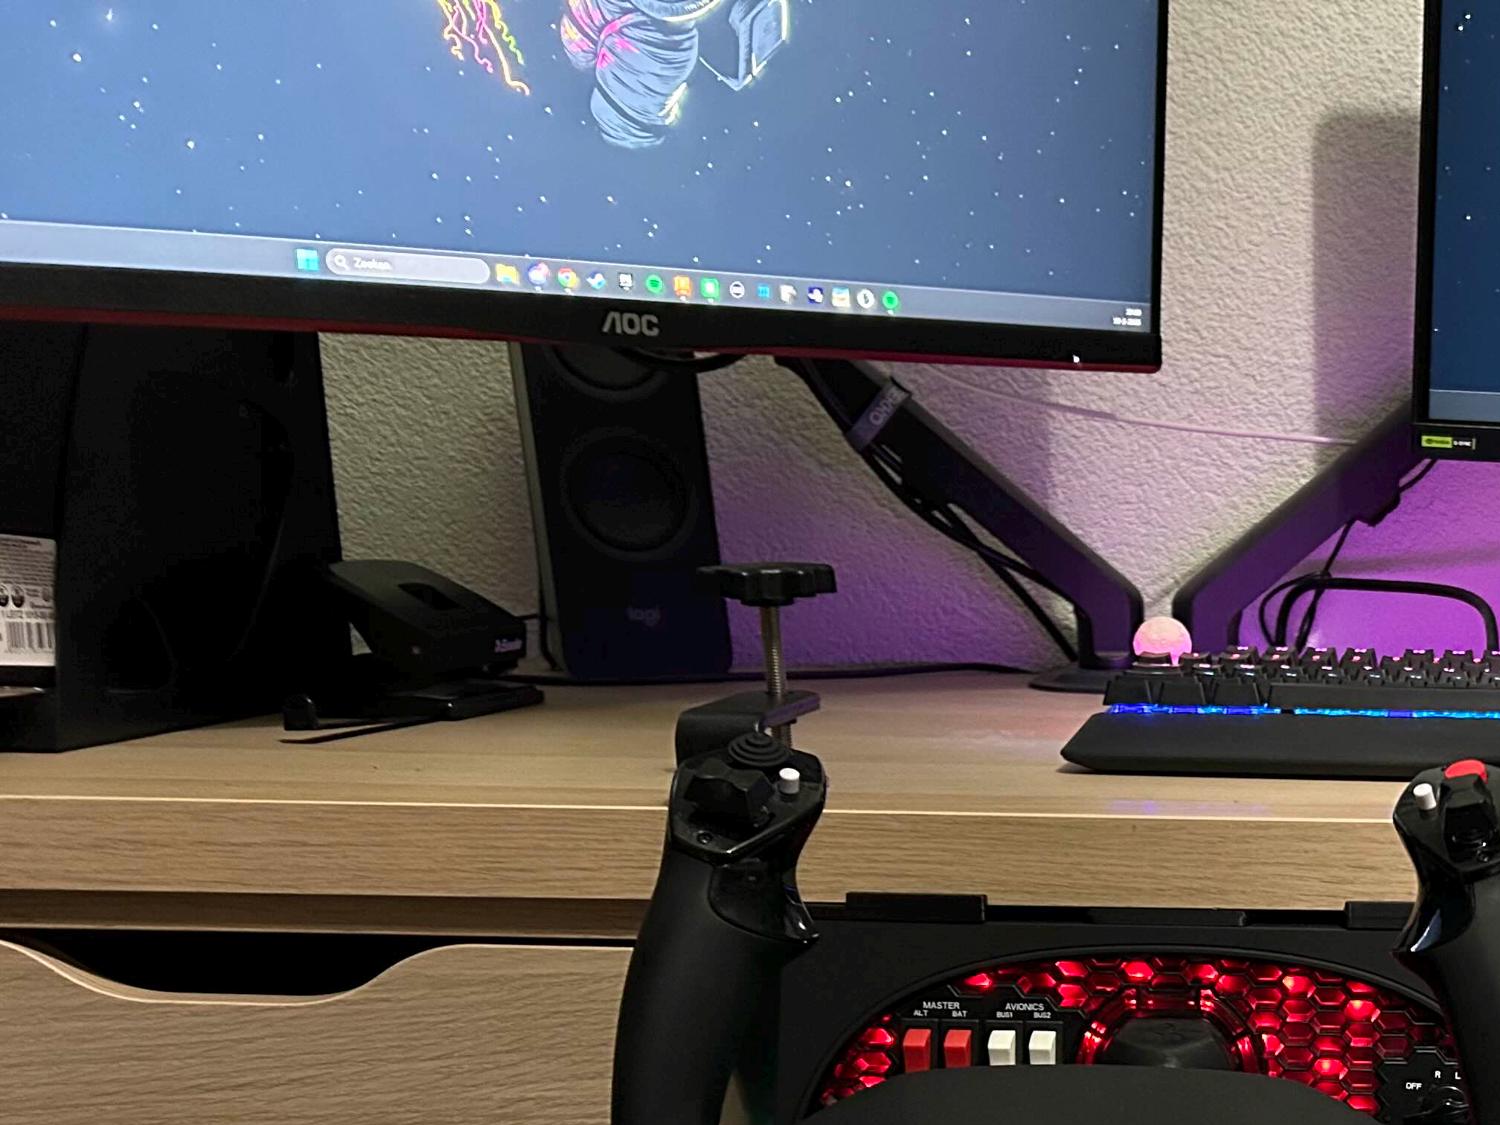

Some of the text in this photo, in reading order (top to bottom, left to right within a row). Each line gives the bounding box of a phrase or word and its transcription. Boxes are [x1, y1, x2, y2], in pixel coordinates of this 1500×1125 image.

[602, 310, 660, 337] AOC
[922, 1001, 961, 1010] MASTER
[1005, 1003, 1045, 1011] AVIONICS
[913, 1009, 929, 1017] ALT
[952, 1010, 969, 1018] BAT
[1434, 1070, 1442, 1079] R
[1454, 1071, 1462, 1080] L
[1405, 1082, 1423, 1091] OFF
